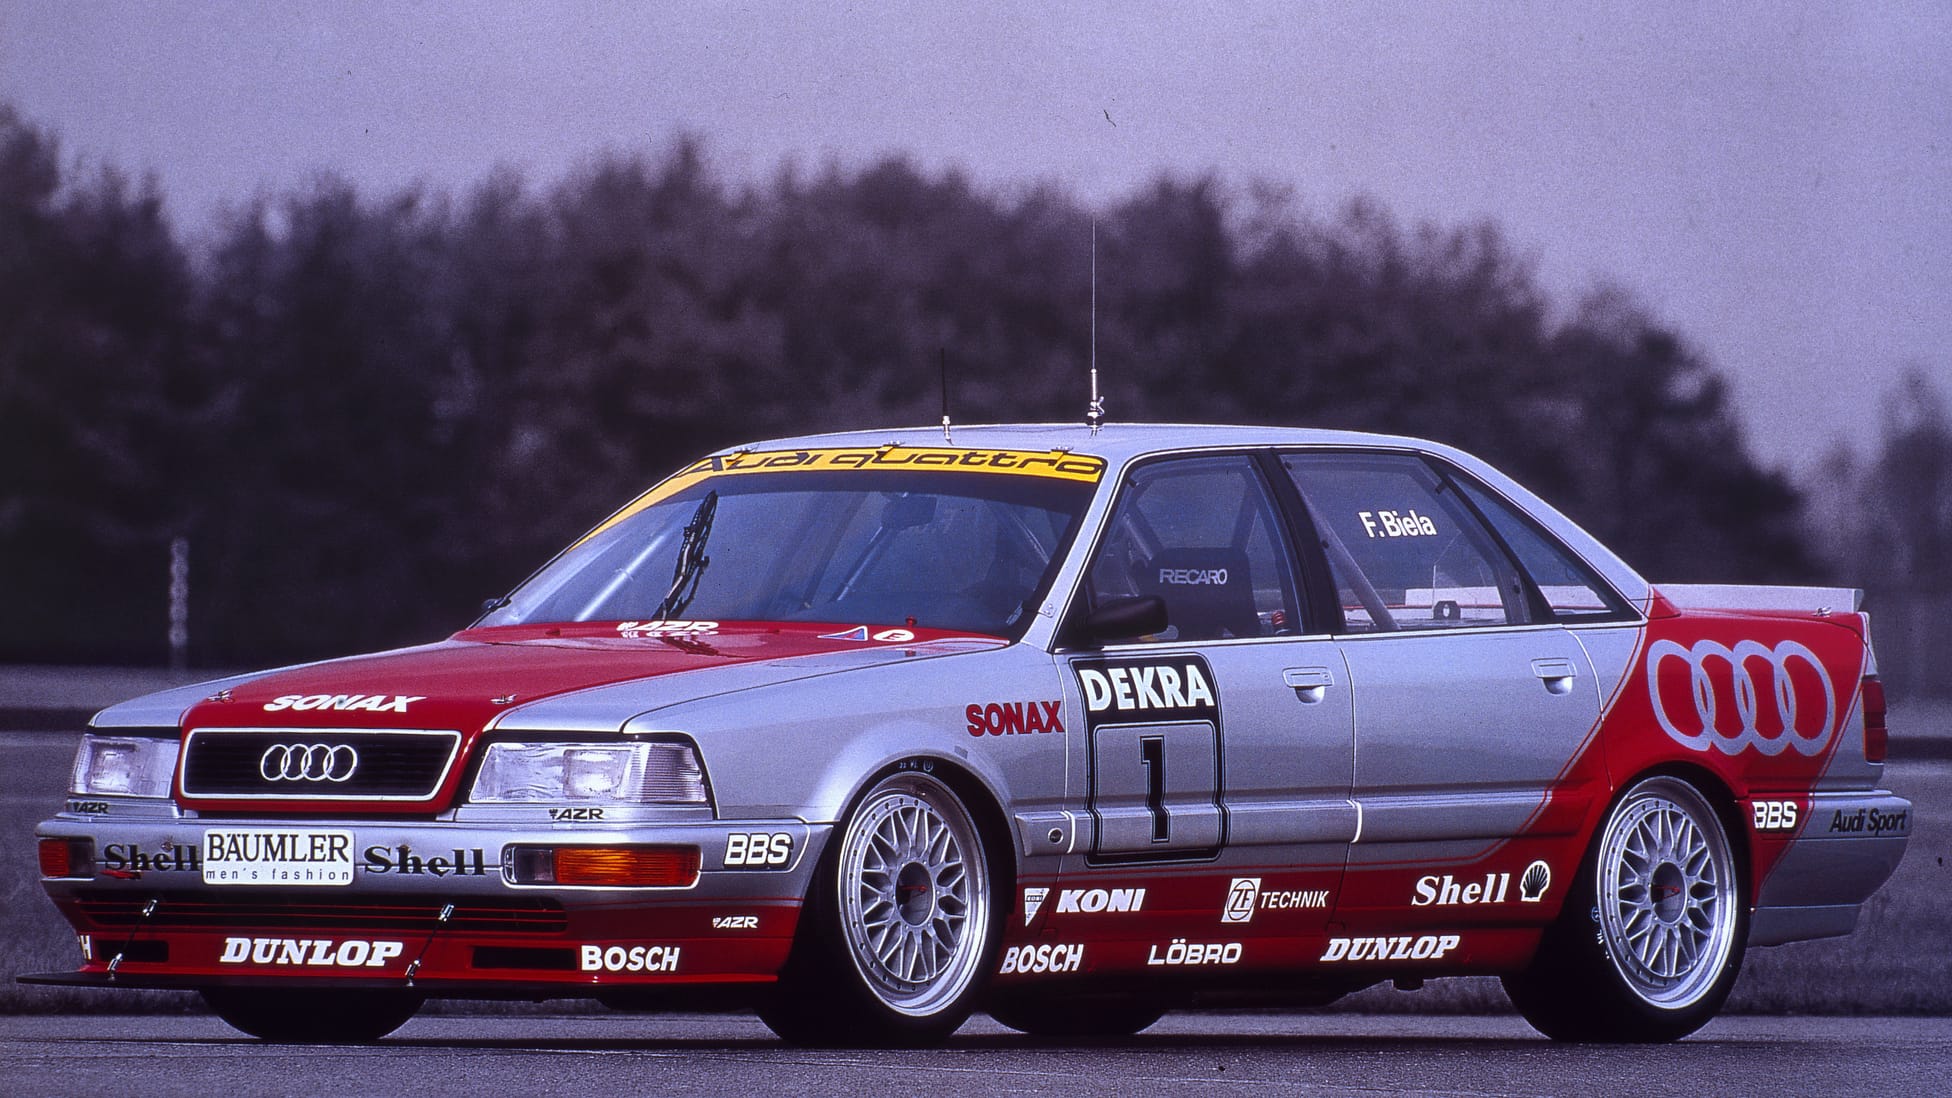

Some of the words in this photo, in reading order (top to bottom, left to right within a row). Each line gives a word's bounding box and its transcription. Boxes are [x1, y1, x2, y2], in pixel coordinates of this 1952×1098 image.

[1159, 568, 1228, 585] RECARO
[1080, 665, 1215, 712] DEKRA
[263, 694, 426, 713] SONAX
[966, 701, 1065, 737] SONAX
[1140, 735, 1169, 842] 1
[79, 802, 109, 813] AZR
[556, 808, 605, 820] AZR
[1752, 801, 1798, 829] BBS
[1829, 809, 1865, 832] Audi
[1867, 808, 1907, 836] Sport
[103, 844, 200, 872] Shell
[206, 833, 349, 863] BÄUMLER
[363, 846, 486, 877] Shell
[724, 834, 791, 865] BBS
[271, 867, 349, 880] fashion
[1056, 888, 1146, 913] KONI
[1260, 890, 1330, 909] TECHNIK
[1411, 873, 1510, 907] Shell
[716, 916, 758, 929] AZR
[219, 938, 402, 967] DUNLOP
[581, 945, 680, 972] BOSCH
[999, 943, 1084, 975] BOSCH
[1147, 938, 1242, 965] LÖBRO
[1319, 935, 1460, 962] DUNLOP
